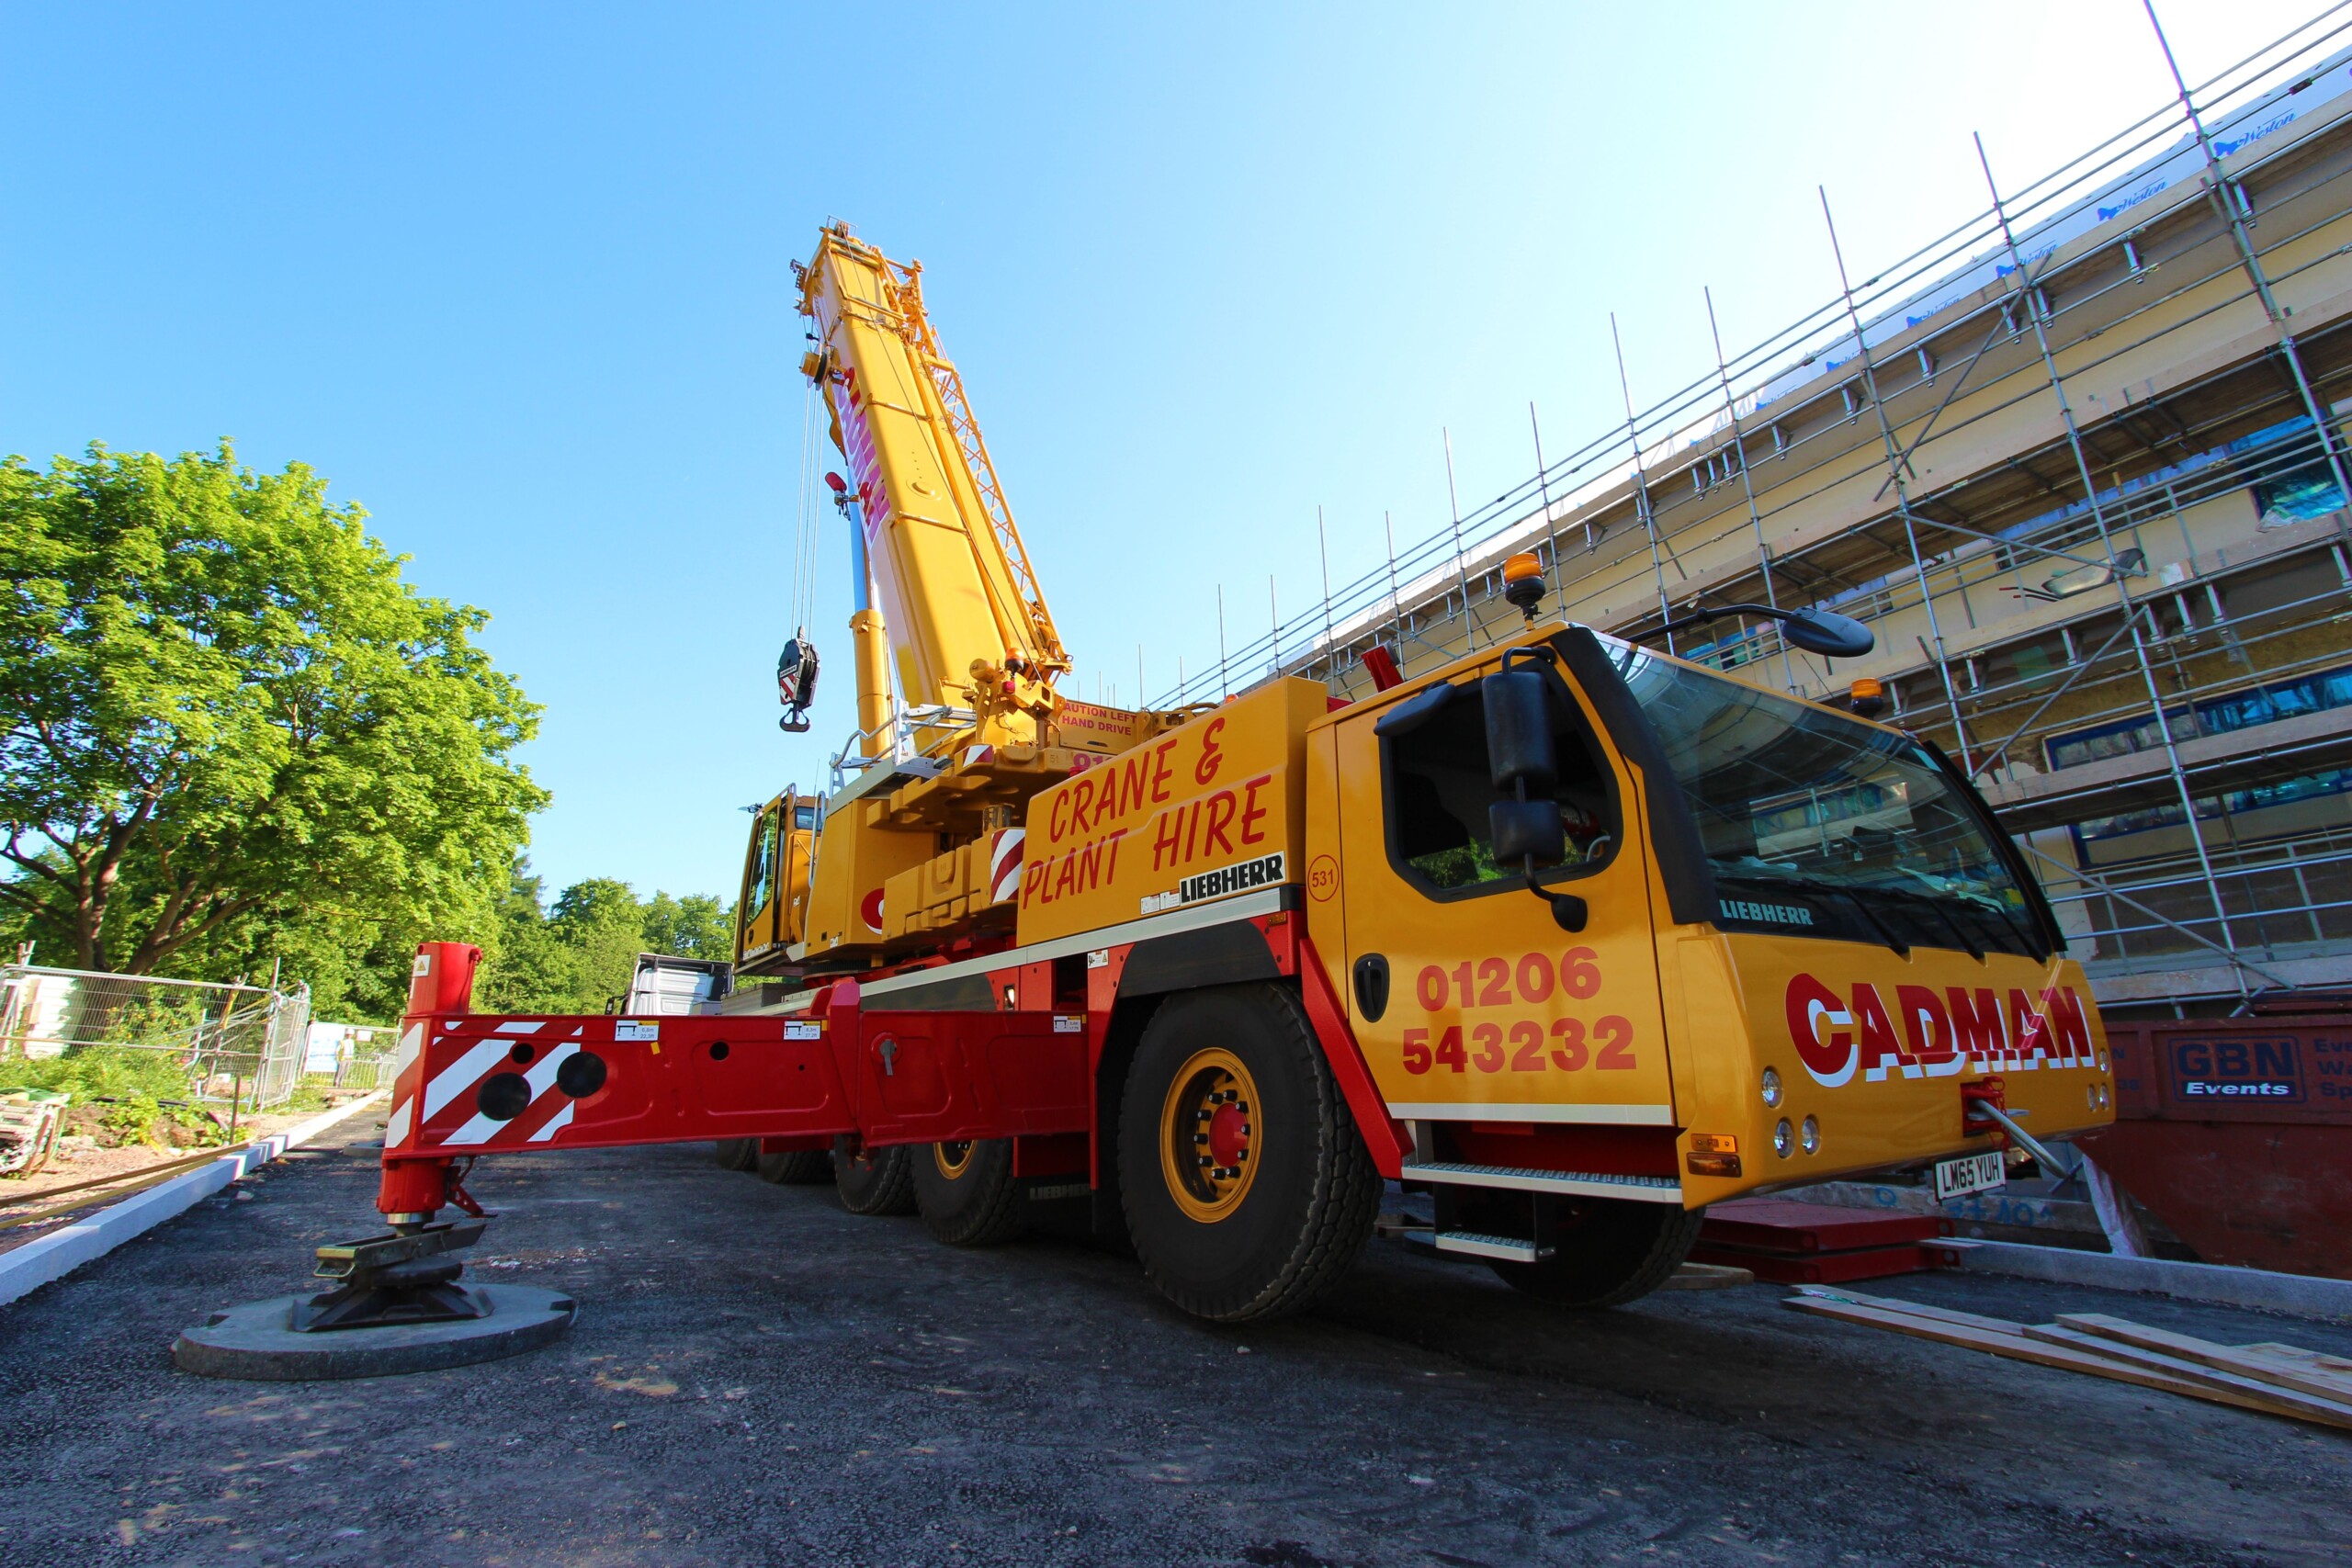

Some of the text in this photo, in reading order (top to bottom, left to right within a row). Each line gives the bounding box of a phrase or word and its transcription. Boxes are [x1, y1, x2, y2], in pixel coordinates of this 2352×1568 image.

[1062, 702, 1137, 725] AUTION LEFT
[1062, 715, 1132, 736] HAND DRIVE
[1050, 717, 1226, 843] CRANE &
[1023, 773, 1272, 909] PLANT HIRE
[1181, 854, 1283, 903] LIEBHERR
[1311, 868, 1334, 888] 531
[1719, 899, 1814, 926] LIEBHERR
[1416, 946, 1602, 1011] 01206
[1402, 1014, 1637, 1075] 543232
[1785, 972, 2096, 1088] CADMAN
[2177, 1042, 2295, 1077] GBN
[2186, 1082, 2290, 1096] Events
[1028, 1182, 1092, 1199] LIEBHER
[1941, 1154, 2000, 1192] LM65 YUH
